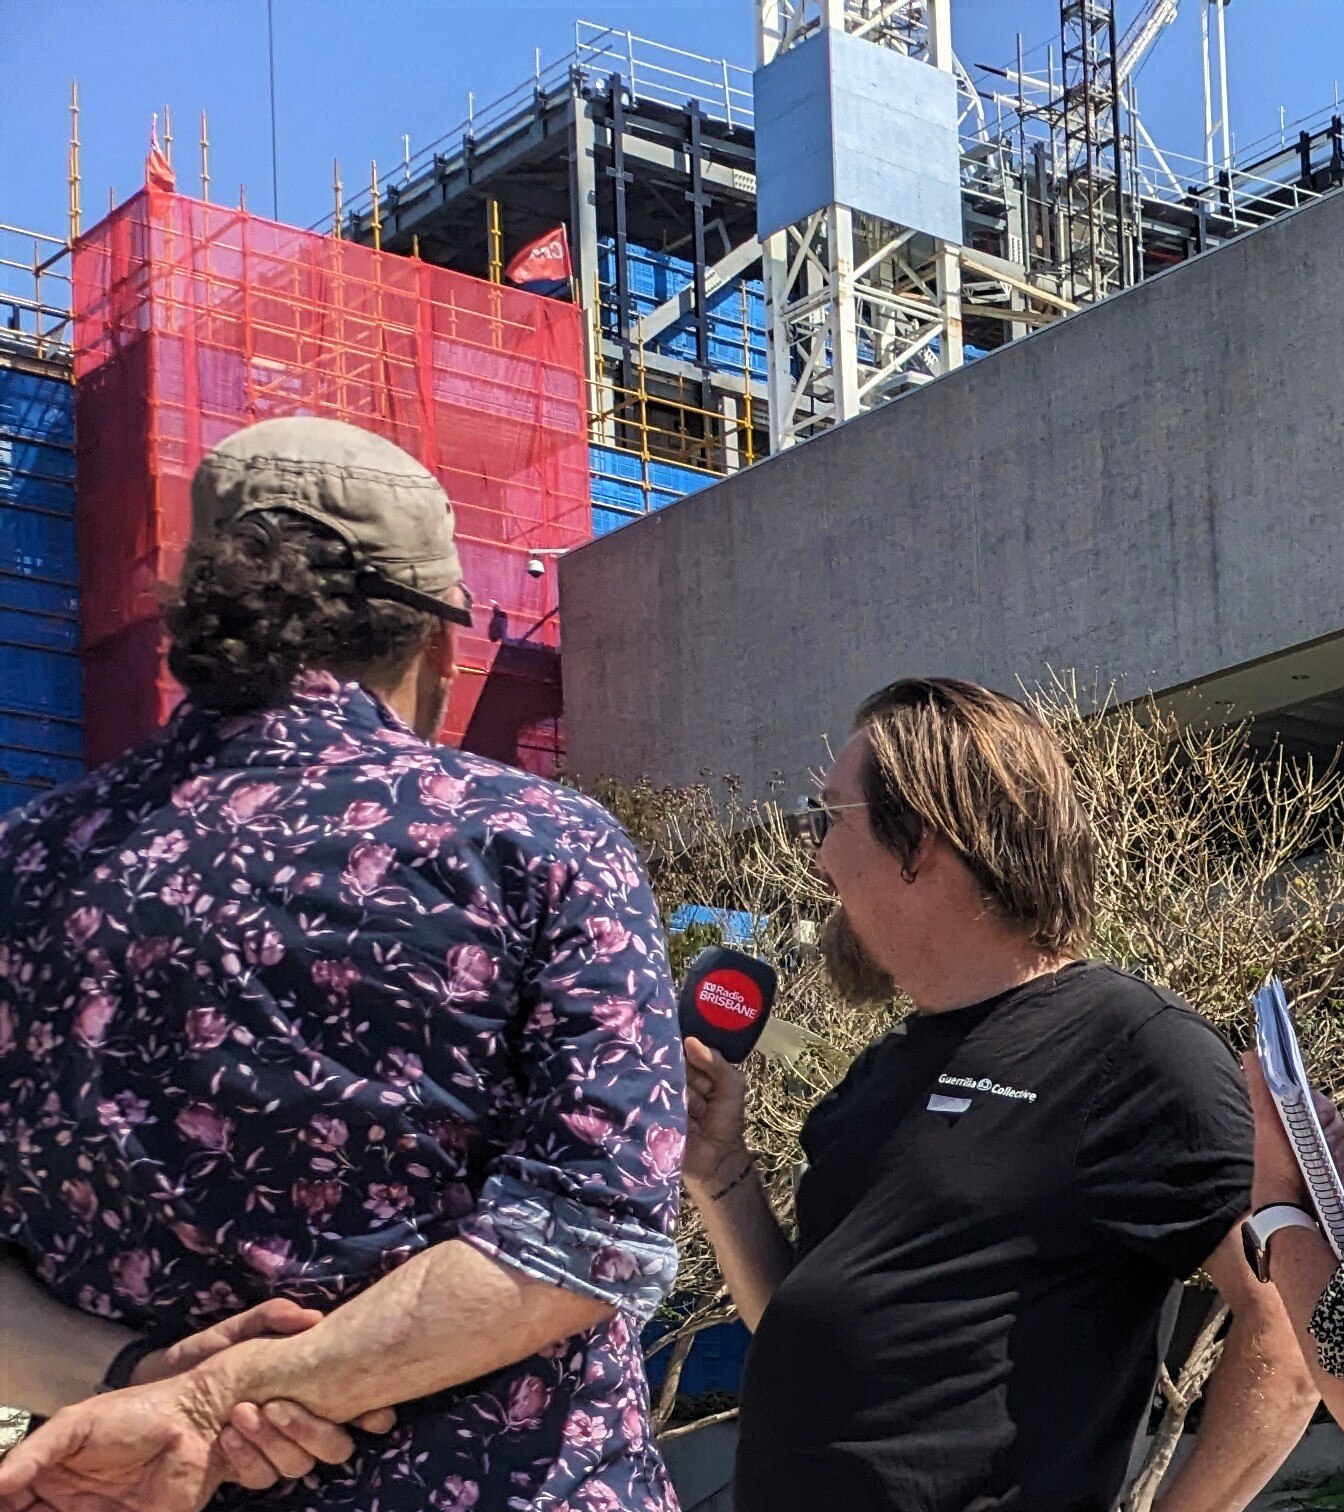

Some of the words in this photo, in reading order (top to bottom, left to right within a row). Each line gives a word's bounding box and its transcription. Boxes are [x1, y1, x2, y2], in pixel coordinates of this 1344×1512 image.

[699, 990, 758, 1020] BRISBANE
[716, 985, 745, 1003] Radio
[938, 1073, 977, 1089] Guerrilla
[991, 1083, 1037, 1102] Collective
